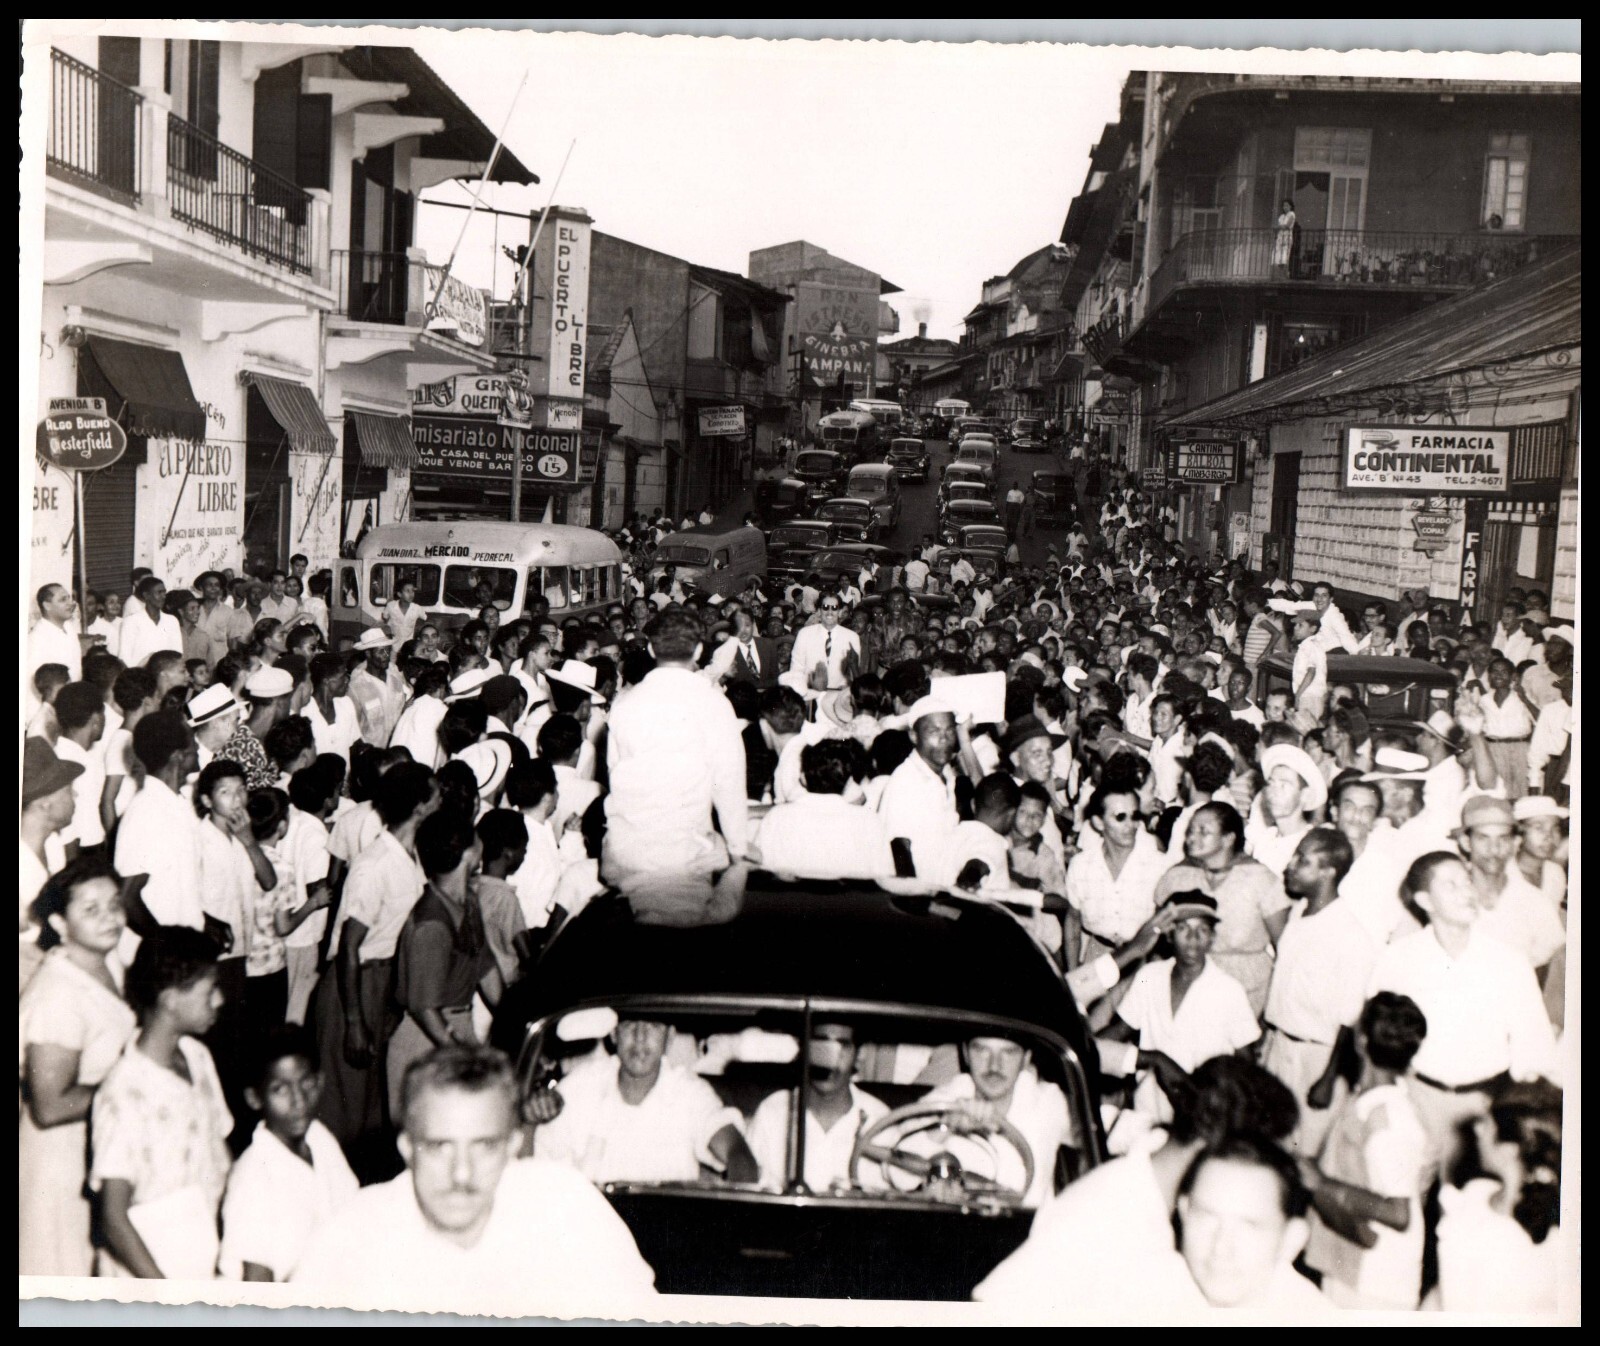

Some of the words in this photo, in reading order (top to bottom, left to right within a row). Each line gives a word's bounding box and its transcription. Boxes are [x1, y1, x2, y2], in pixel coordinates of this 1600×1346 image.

[559, 227, 579, 242] EL
[555, 245, 571, 332] PUERTO
[569, 314, 584, 386] LIBRE
[804, 335, 871, 357] GINEBRA
[804, 356, 872, 374] AMPANA
[50, 398, 88, 410] AVENIDA
[76, 416, 111, 430] BUENO
[413, 423, 497, 448] misariato
[1411, 435, 1495, 450] FARMACIA
[420, 447, 435, 456] LA
[440, 448, 469, 458] CASA
[473, 451, 491, 460] DEL
[495, 453, 534, 463] PUELO
[1189, 443, 1224, 454] CANTINA
[175, 442, 232, 477] PUERTO
[449, 459, 483, 469] VENDE
[488, 461, 534, 472] BARTO
[1187, 454, 1226, 469] BALBOA
[1354, 451, 1500, 474] CONTINENTAL
[544, 462, 561, 474] 15
[1352, 473, 1375, 483] AVE.
[1406, 474, 1421, 483] 43
[1445, 475, 1468, 484] TEL.
[1470, 476, 1503, 486] 2-4671
[198, 482, 237, 512] LIBRE
[1417, 516, 1452, 525] REVELADO
[1421, 527, 1445, 535] COPIAS
[424, 545, 470, 557] MERCADO
[1460, 532, 1480, 627] FARMA
